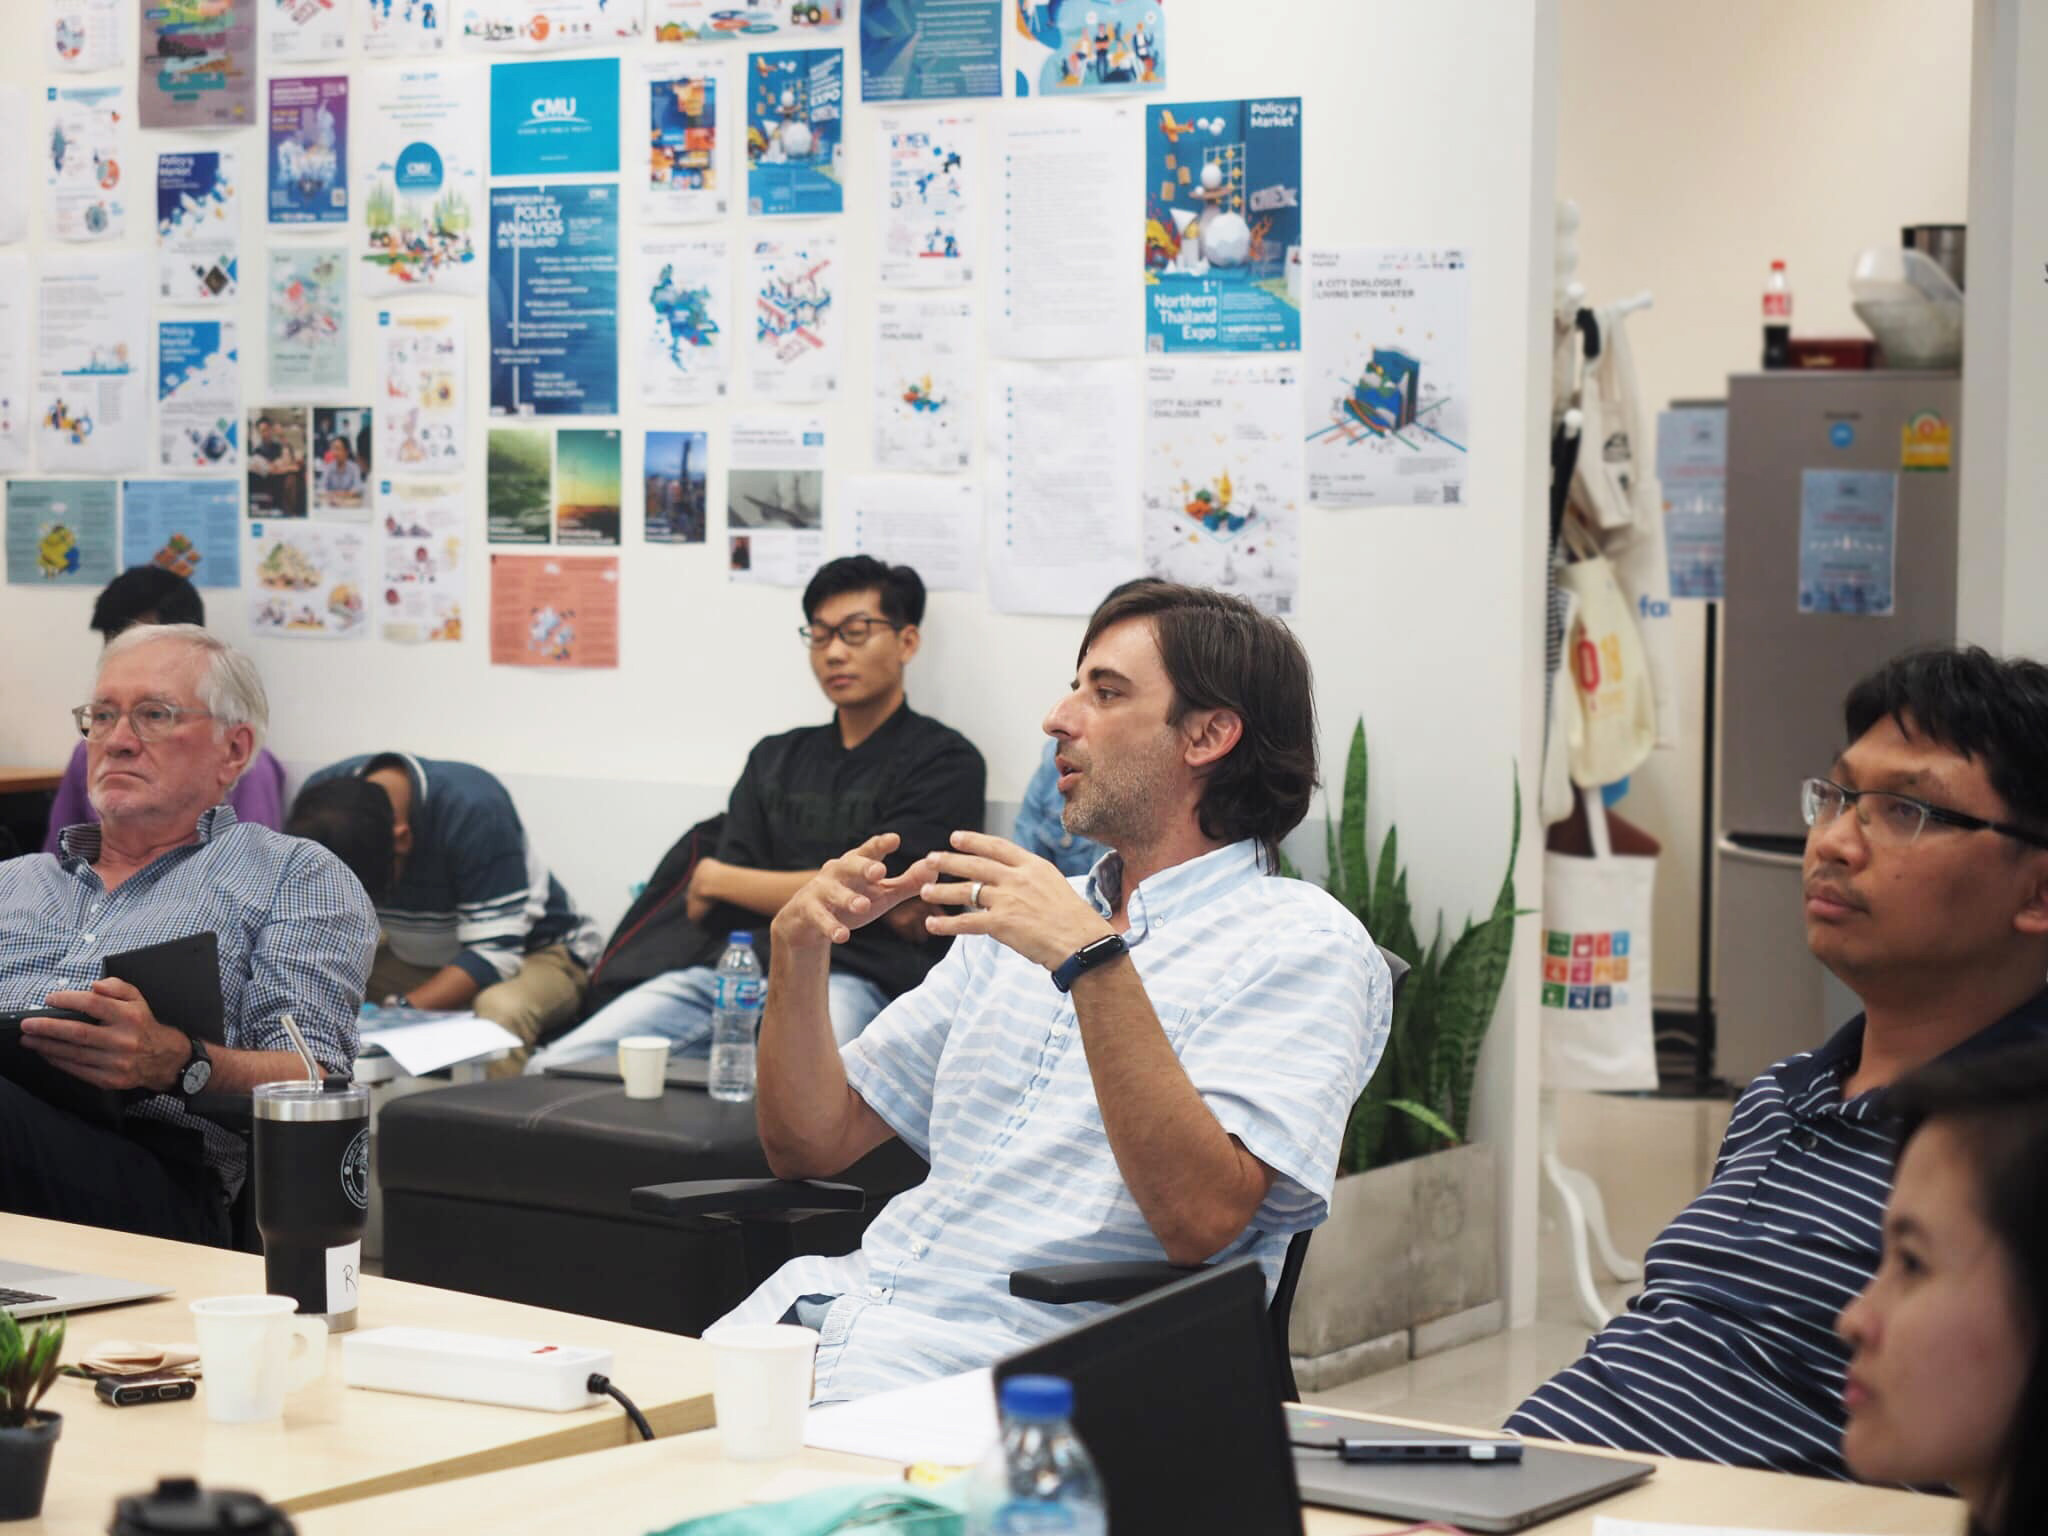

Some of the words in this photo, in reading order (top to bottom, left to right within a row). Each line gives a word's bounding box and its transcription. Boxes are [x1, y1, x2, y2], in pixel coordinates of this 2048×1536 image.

[532, 96, 577, 118] CMU
[1250, 115, 1295, 129] Market
[514, 204, 562, 222] POLICY
[497, 219, 565, 238] ANALYSIS
[1326, 279, 1347, 287] CITY
[1350, 278, 1402, 288] DIALOGUE
[1154, 293, 1217, 309] Northern
[1381, 288, 1415, 298] WATER
[1159, 308, 1217, 325] Thailand
[1182, 324, 1217, 342] Expo
[343, 1264, 360, 1293] R
